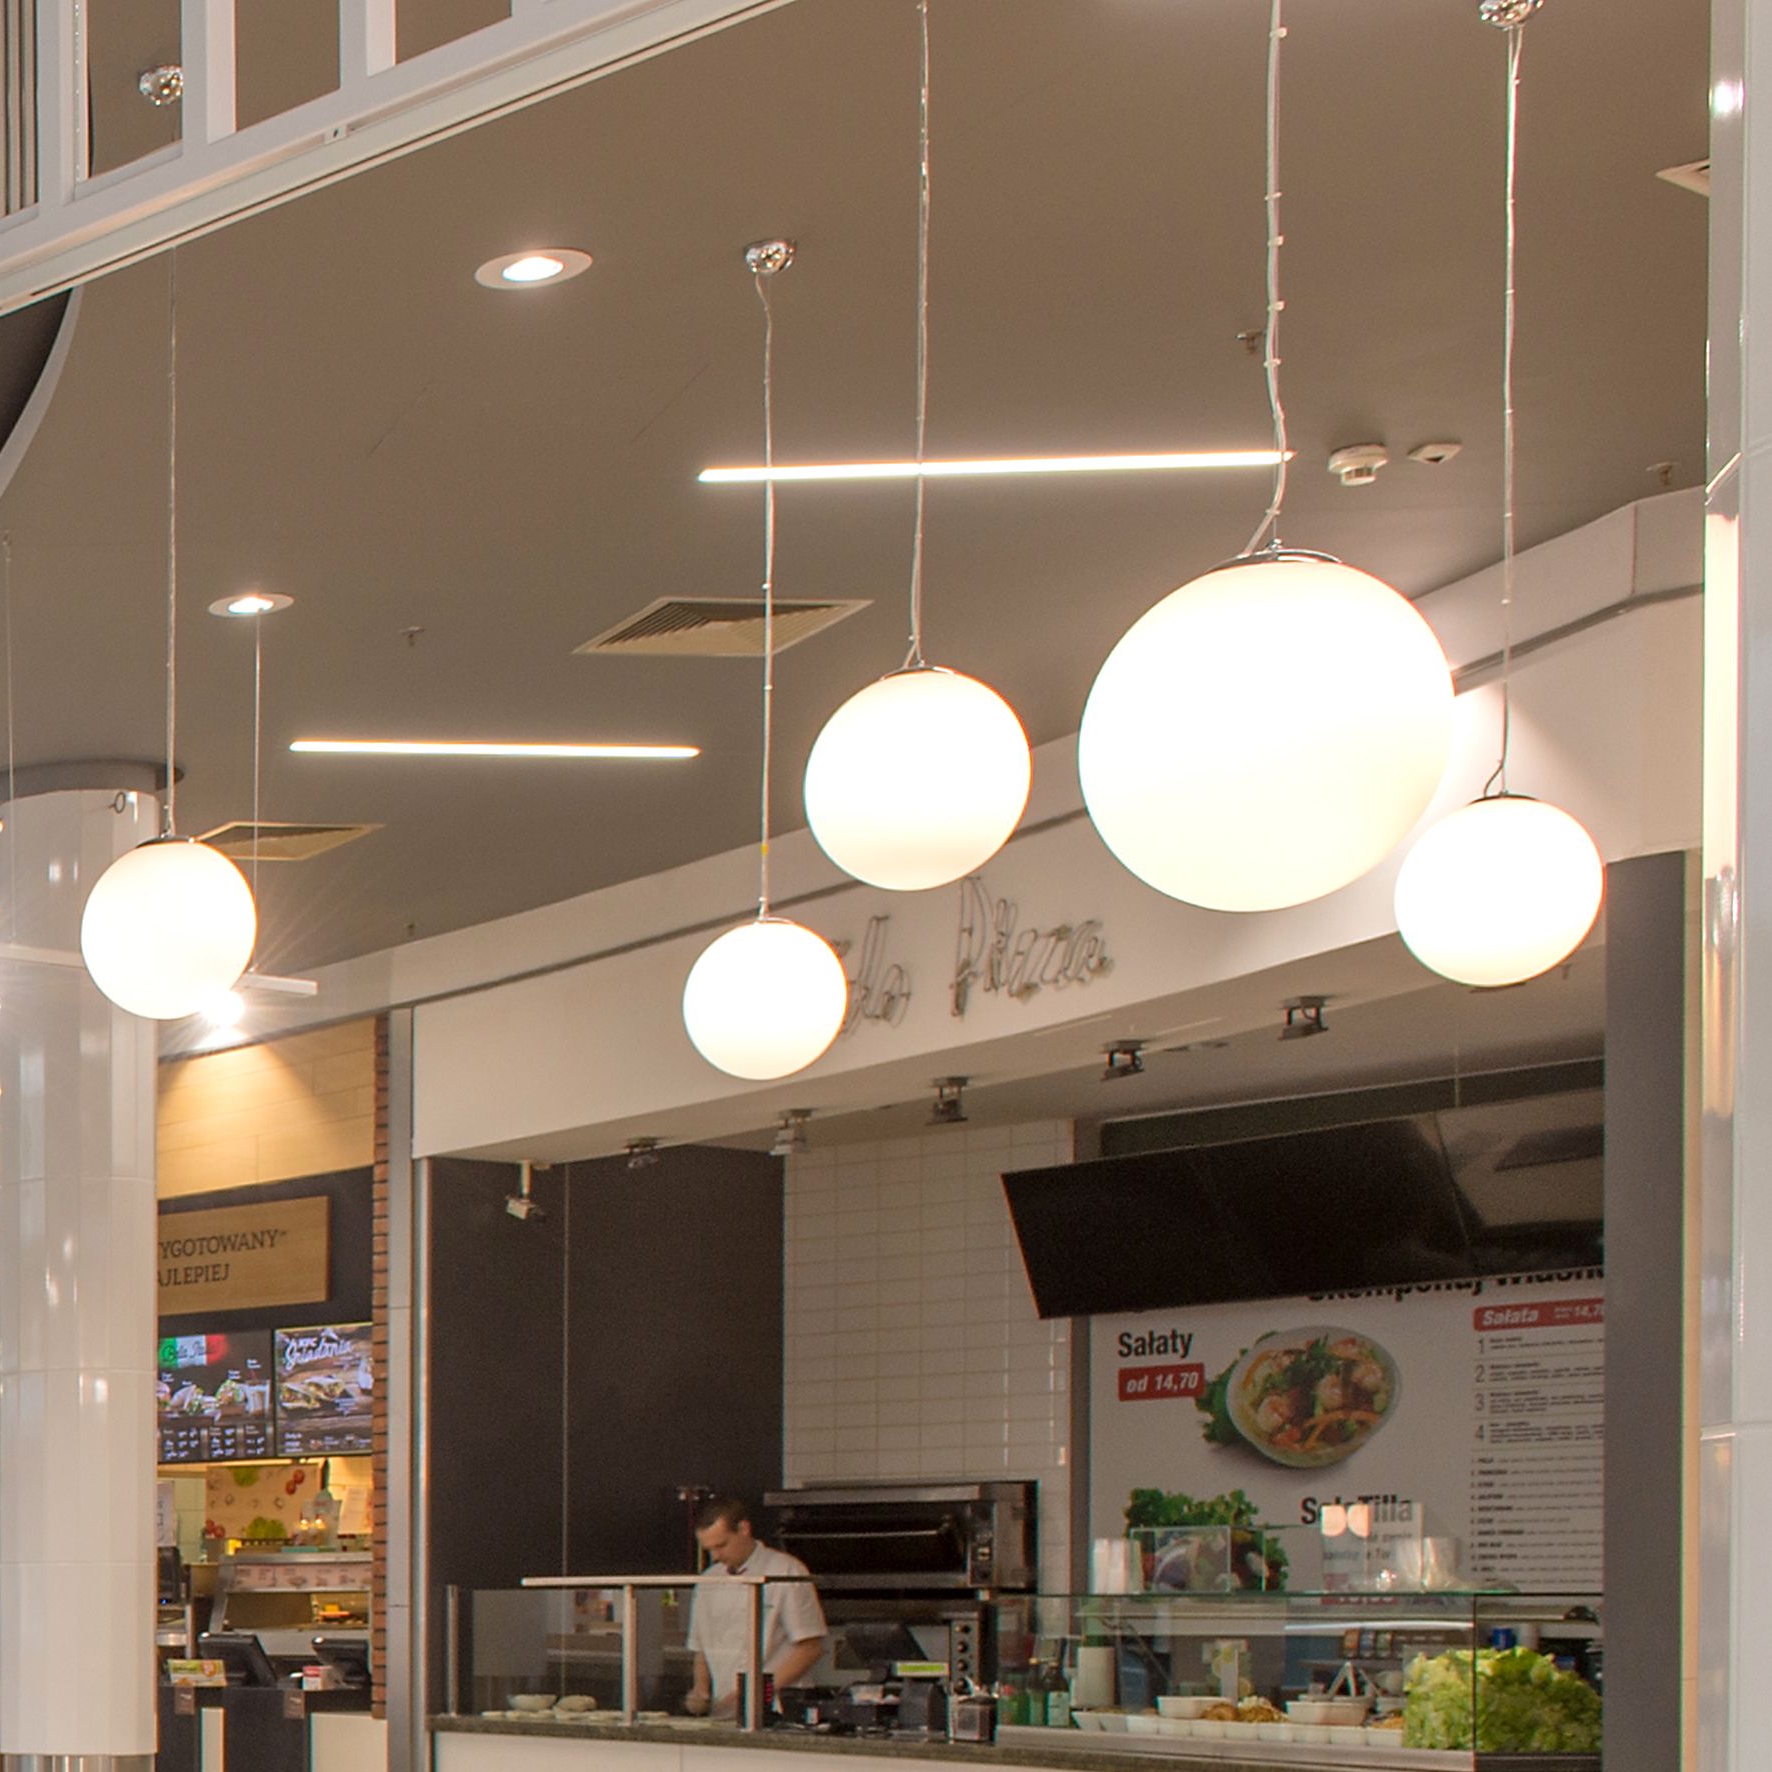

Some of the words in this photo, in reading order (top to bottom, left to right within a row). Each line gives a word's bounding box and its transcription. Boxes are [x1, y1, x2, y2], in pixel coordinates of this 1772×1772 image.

[1118, 1328, 1193, 1358] Sałaty
[1126, 1375, 1148, 1393] od
[1155, 1371, 1199, 1391] 14,70
